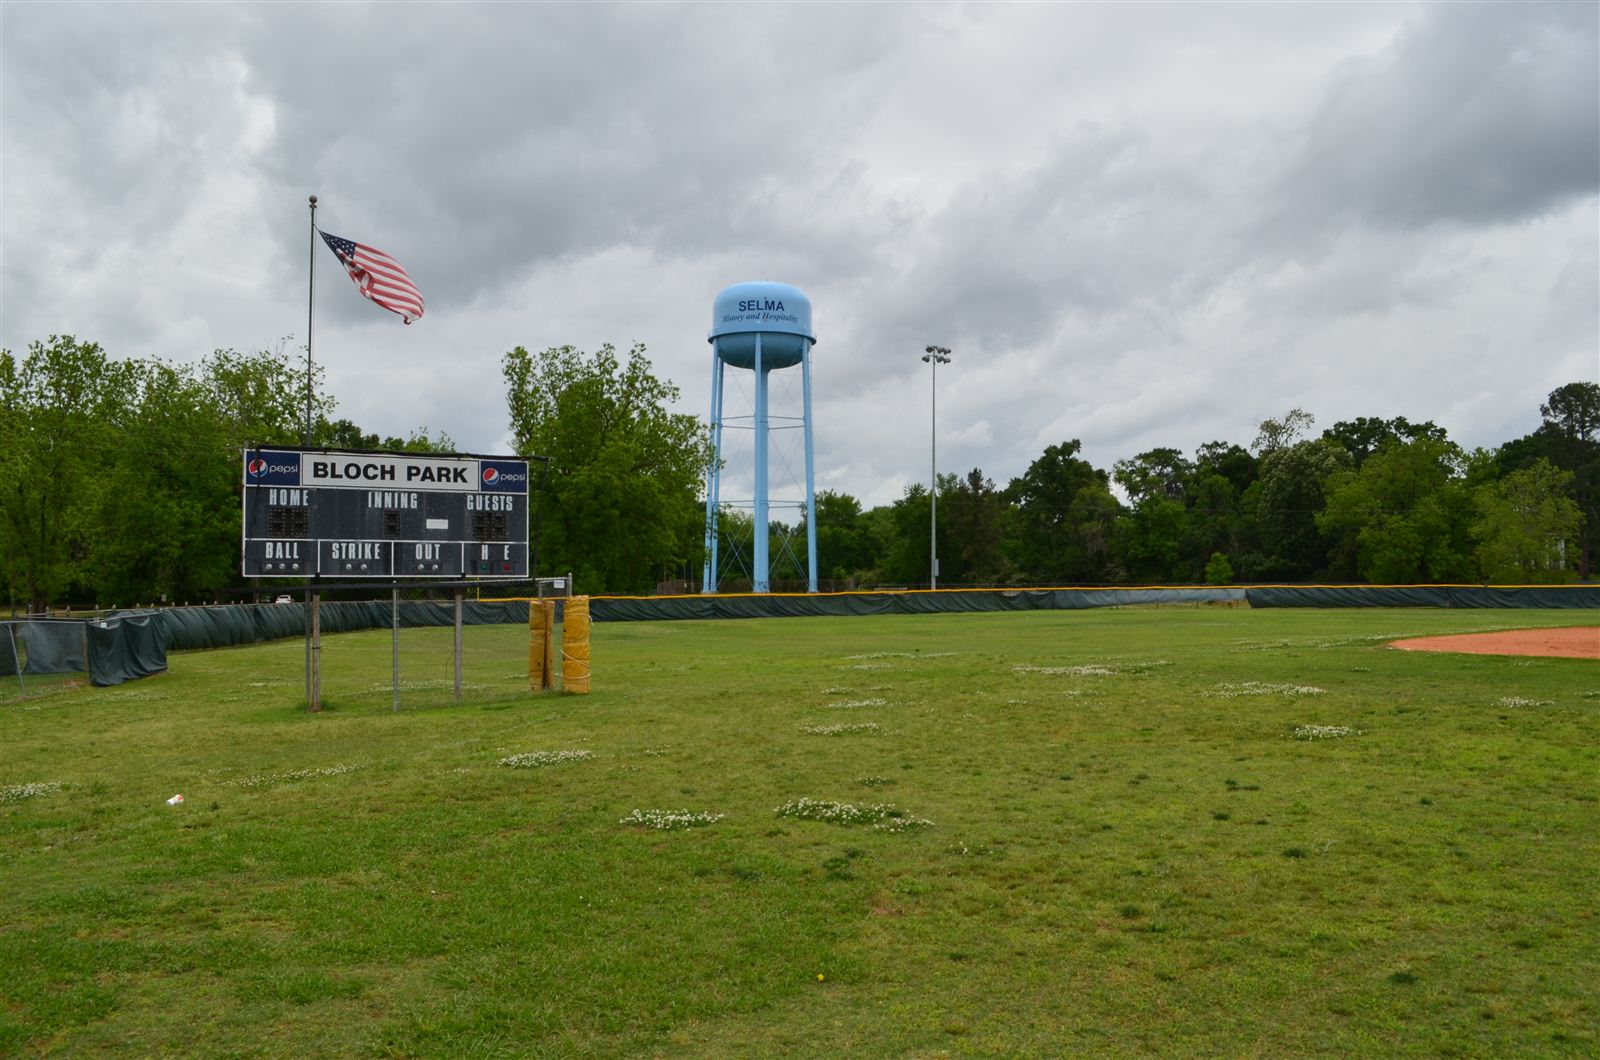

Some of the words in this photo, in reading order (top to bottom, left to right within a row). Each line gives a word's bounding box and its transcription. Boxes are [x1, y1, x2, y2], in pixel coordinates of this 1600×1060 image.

[739, 300, 785, 312] SELMA
[722, 313, 744, 323] History
[746, 312, 760, 320] and
[762, 312, 799, 324] Hospitality
[269, 464, 298, 475] pepsi
[313, 461, 395, 481] BLOCH
[406, 465, 469, 483] PARK
[500, 472, 526, 484] pepsi
[269, 488, 309, 506] HOME
[368, 491, 418, 509] INNING
[466, 494, 513, 511] GUESTS
[265, 542, 299, 559] BALL
[332, 542, 380, 560] STRIKE
[415, 543, 440, 560] OUT
[481, 544, 489, 560] H
[503, 545, 510, 560] E
